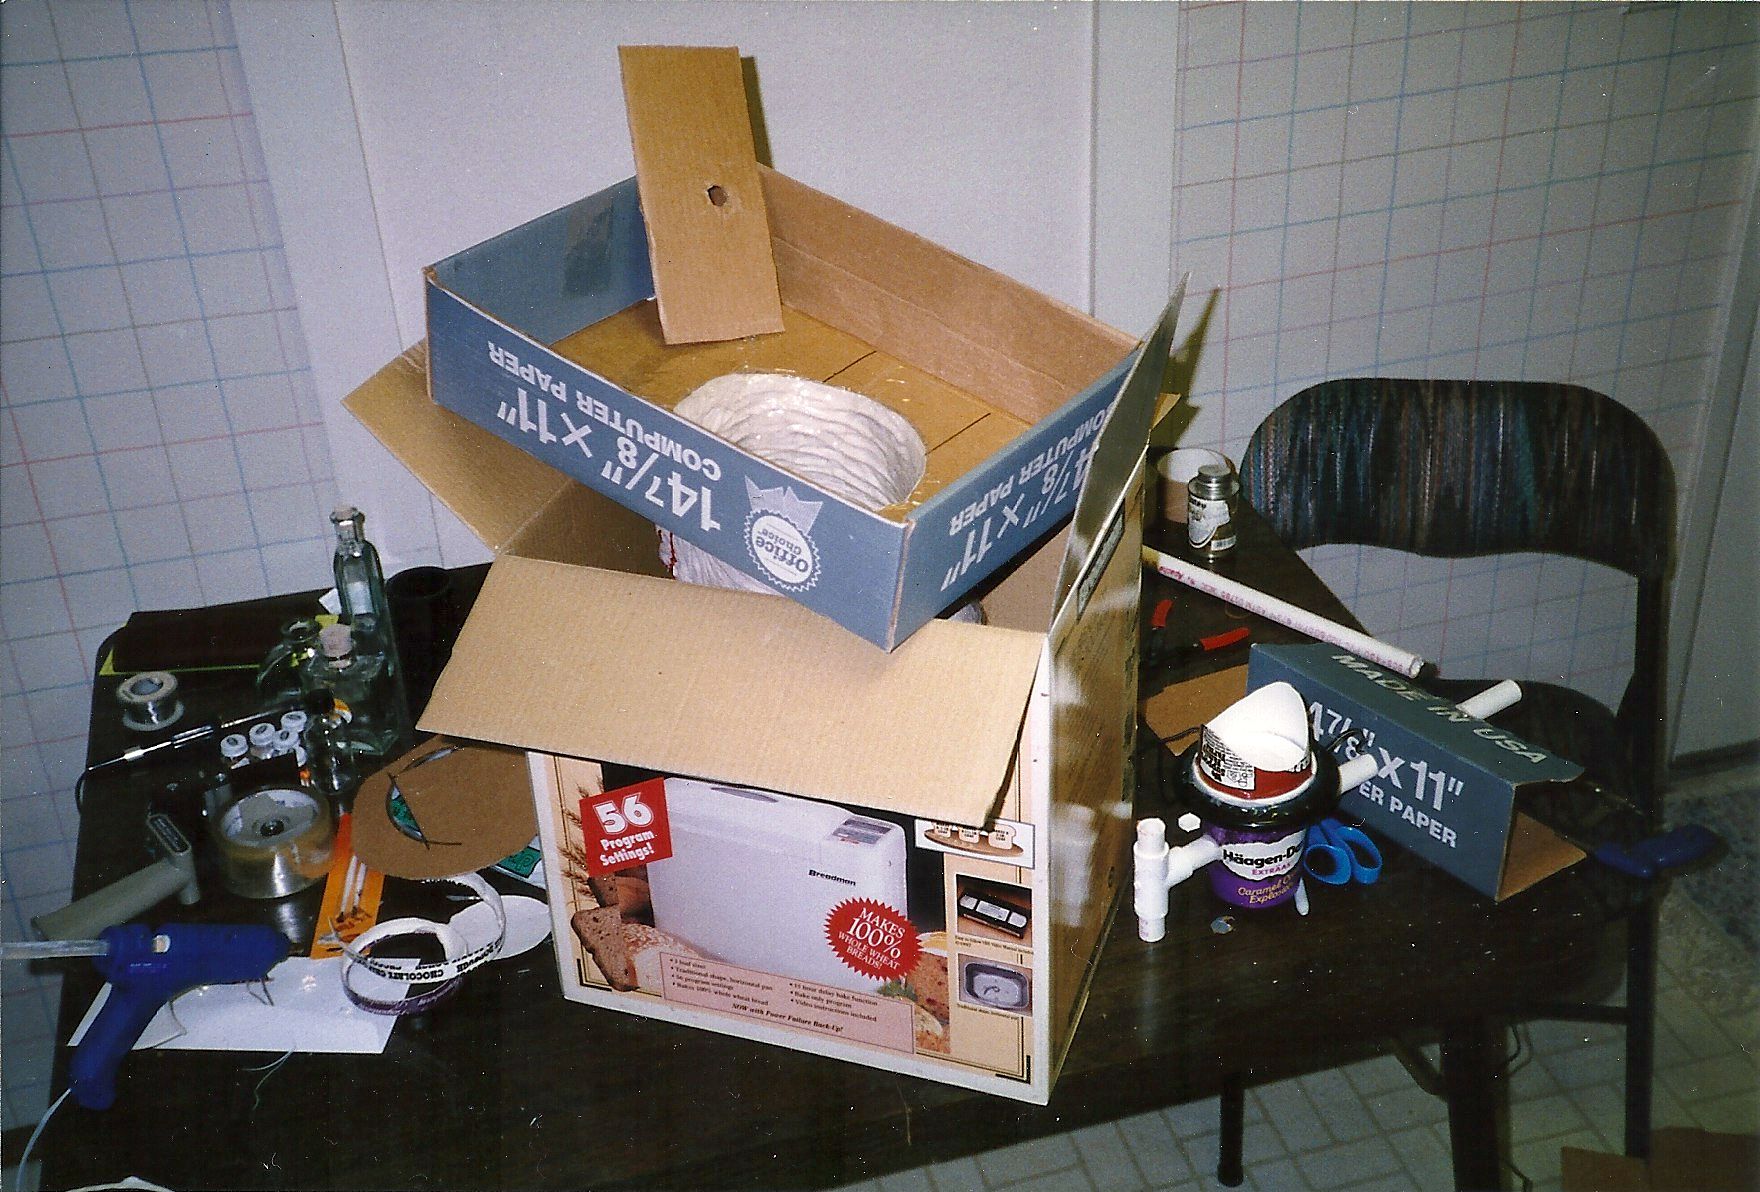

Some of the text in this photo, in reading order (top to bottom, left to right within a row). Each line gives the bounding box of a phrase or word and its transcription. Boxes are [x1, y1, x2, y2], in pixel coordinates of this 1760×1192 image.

[488, 341, 722, 482] COMPUTER PAPER
[949, 475, 1014, 536] PAPER
[755, 536, 809, 573] Office
[1331, 654, 1548, 764] MADE IN USA
[592, 791, 654, 835] 56
[1389, 795, 1458, 848] PAPER
[600, 830, 655, 851] Program
[600, 841, 655, 866] Settings!
[808, 869, 857, 887] Breadman
[1238, 879, 1281, 896] Caramel
[859, 907, 906, 939] MAKES
[847, 917, 902, 959] 100%
[838, 931, 901, 970] WHOLE WHEAT
[846, 946, 884, 970] BREADS!
[675, 966, 709, 978] Traditional
[729, 976, 761, 988] horizontal
[684, 976, 710, 986] program
[732, 993, 750, 1002] wheat
[826, 998, 852, 1009] program
[731, 1002, 749, 1011] NOW
[749, 1006, 764, 1015] with
[765, 1010, 787, 1020] Power
[787, 1014, 812, 1026] Failure
[814, 1003, 850, 1016] instructions
[850, 1011, 877, 1022] included
